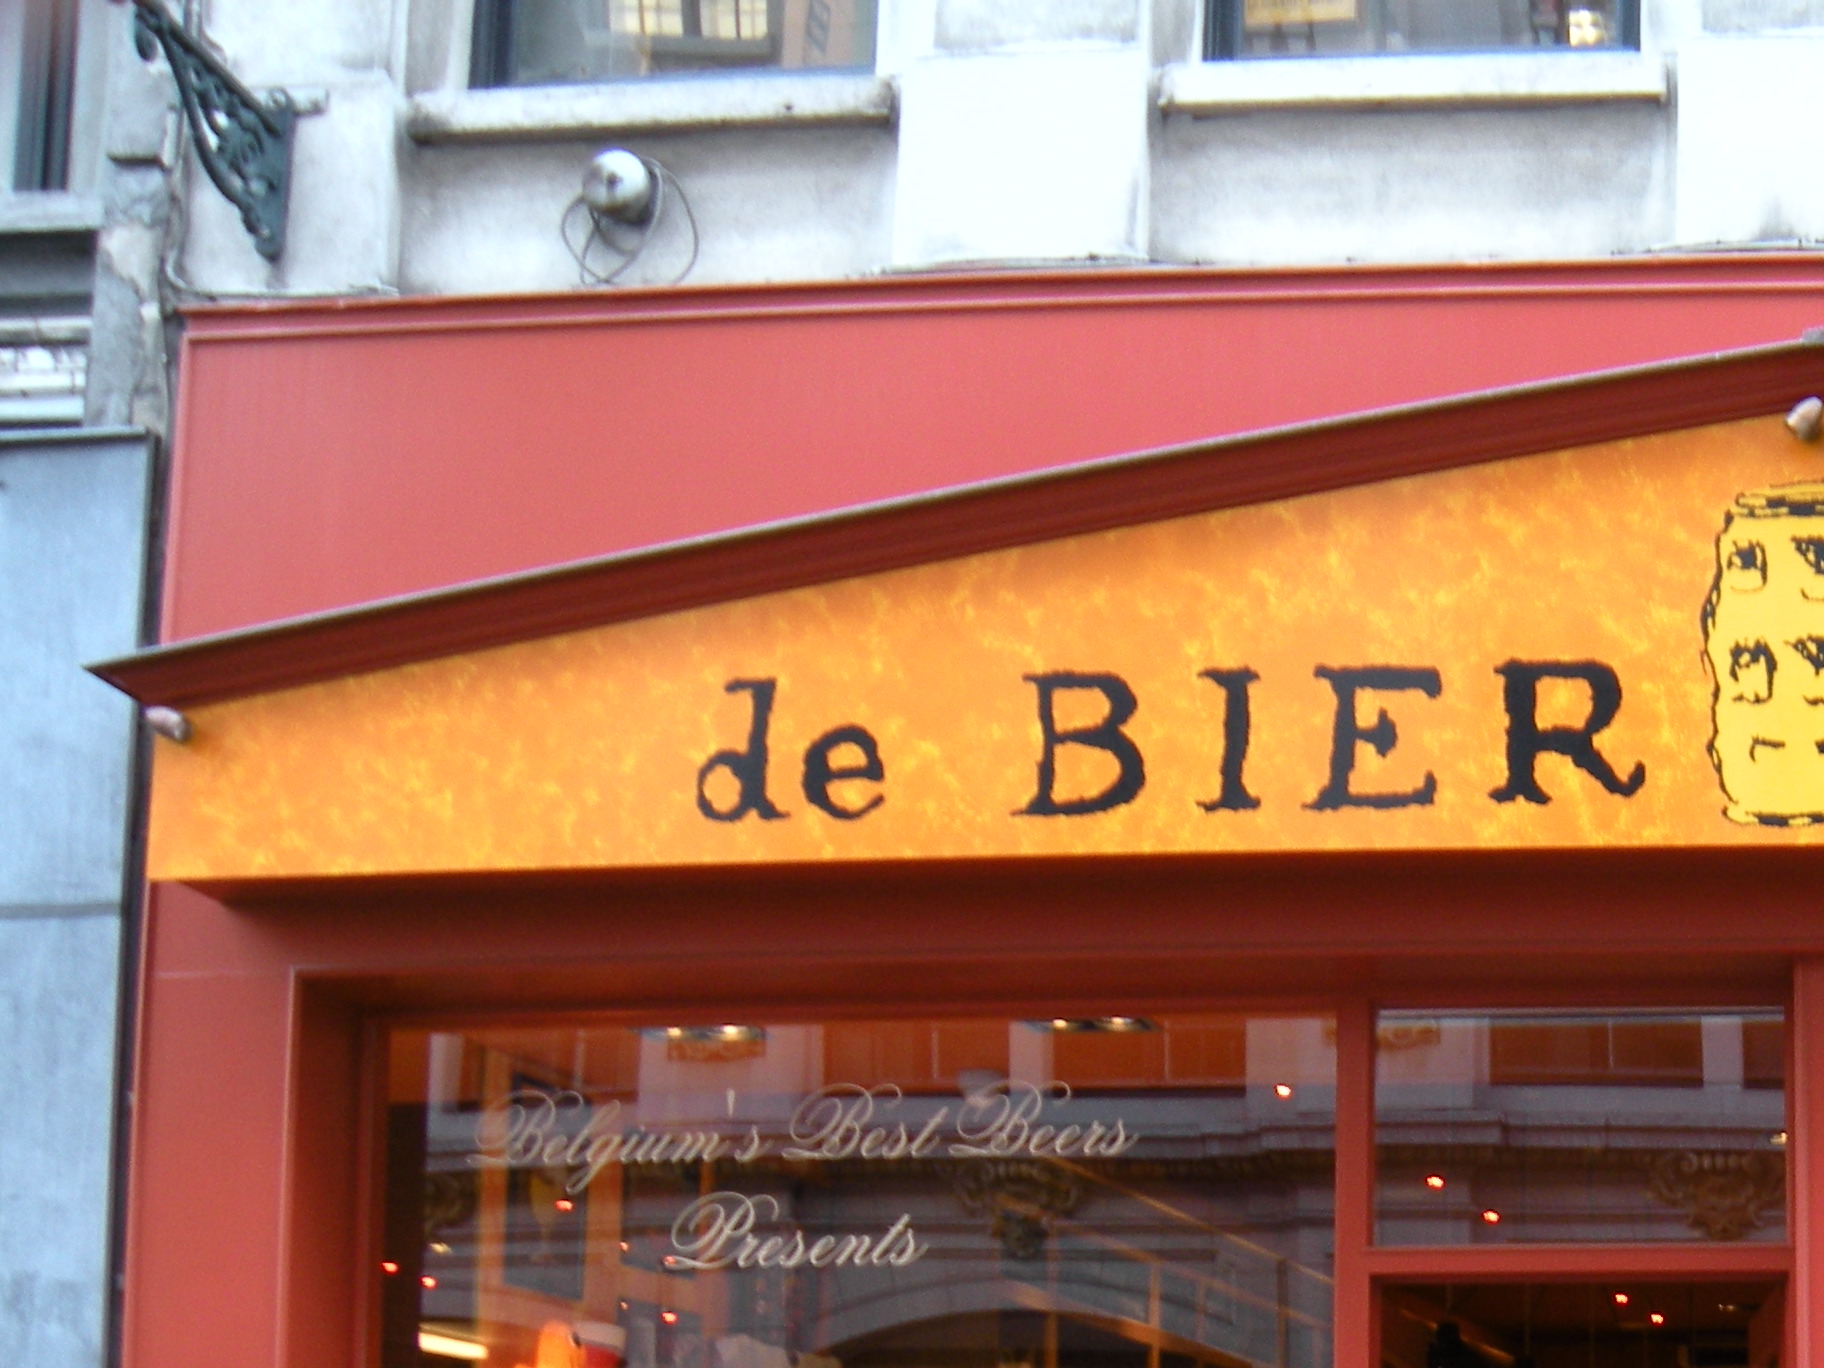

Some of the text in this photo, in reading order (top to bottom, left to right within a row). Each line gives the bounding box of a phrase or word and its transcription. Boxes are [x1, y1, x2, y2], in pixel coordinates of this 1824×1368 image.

[697, 677, 886, 822] de
[1011, 658, 1646, 816] BIER
[466, 1079, 1139, 1196] Belgium's Best Beers
[662, 1191, 930, 1271] Presents
